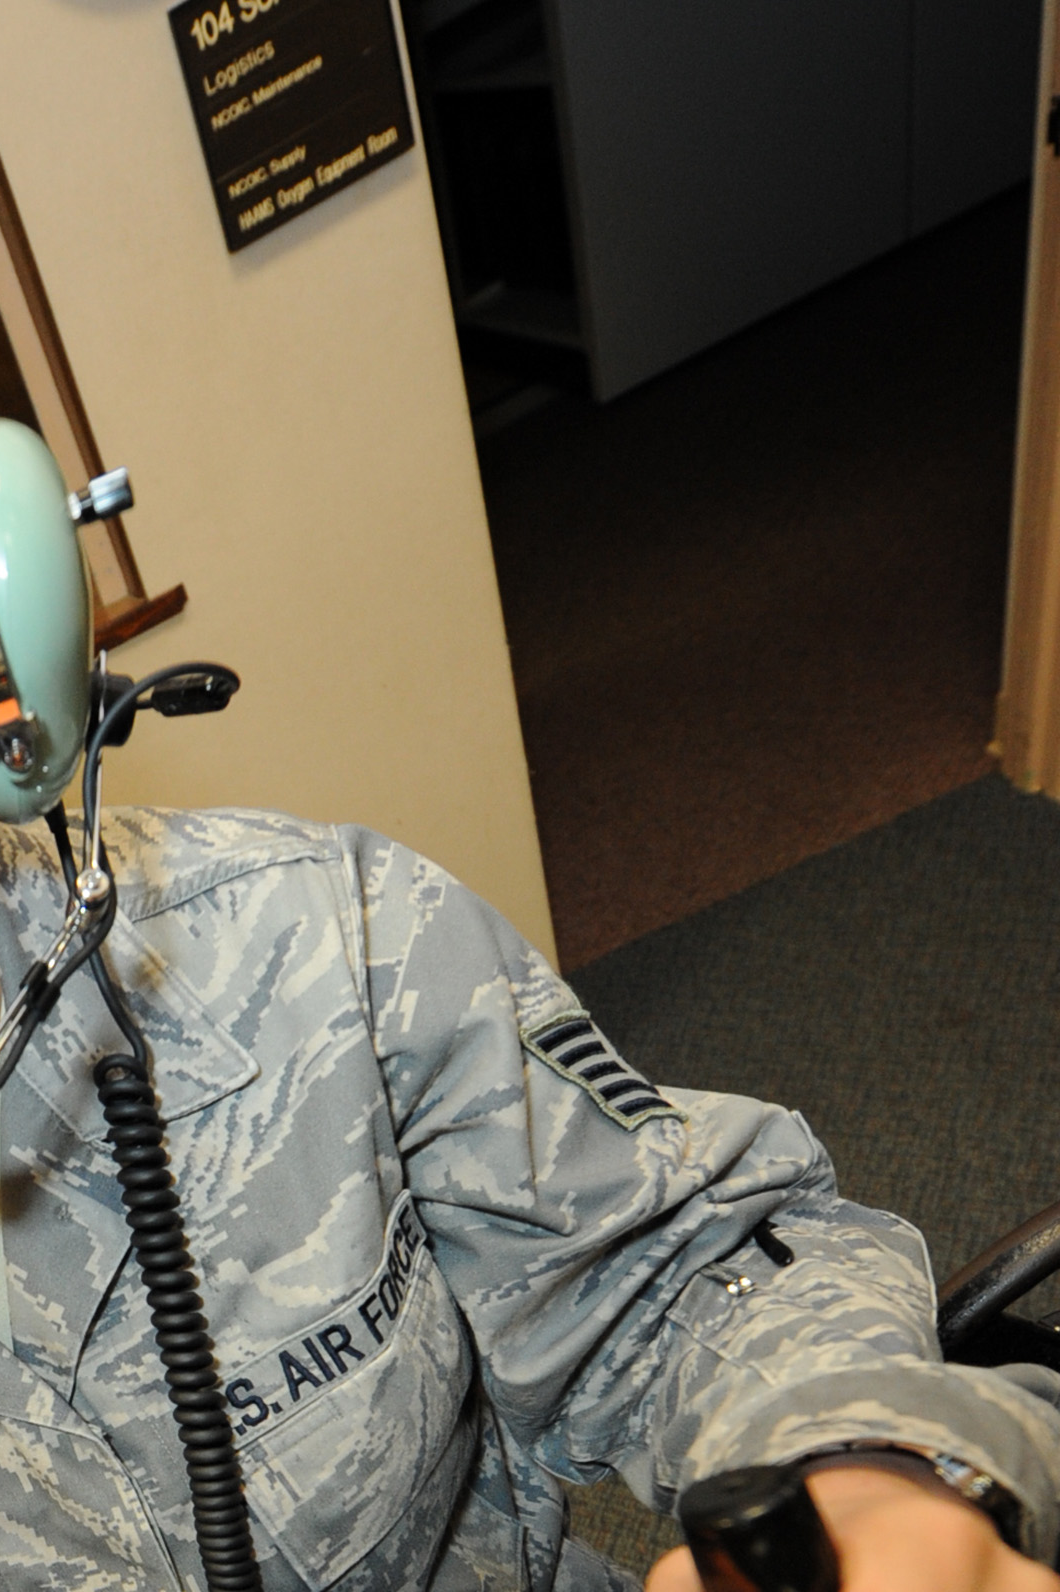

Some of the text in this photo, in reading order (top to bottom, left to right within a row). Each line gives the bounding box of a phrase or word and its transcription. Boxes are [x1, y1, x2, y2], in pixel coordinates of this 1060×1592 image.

[191, 1, 235, 51] 104
[203, 40, 276, 96] Logistics
[252, 55, 323, 106] Maintenance
[278, 1323, 366, 1403] AIR
[358, 1204, 422, 1345] FORCE
